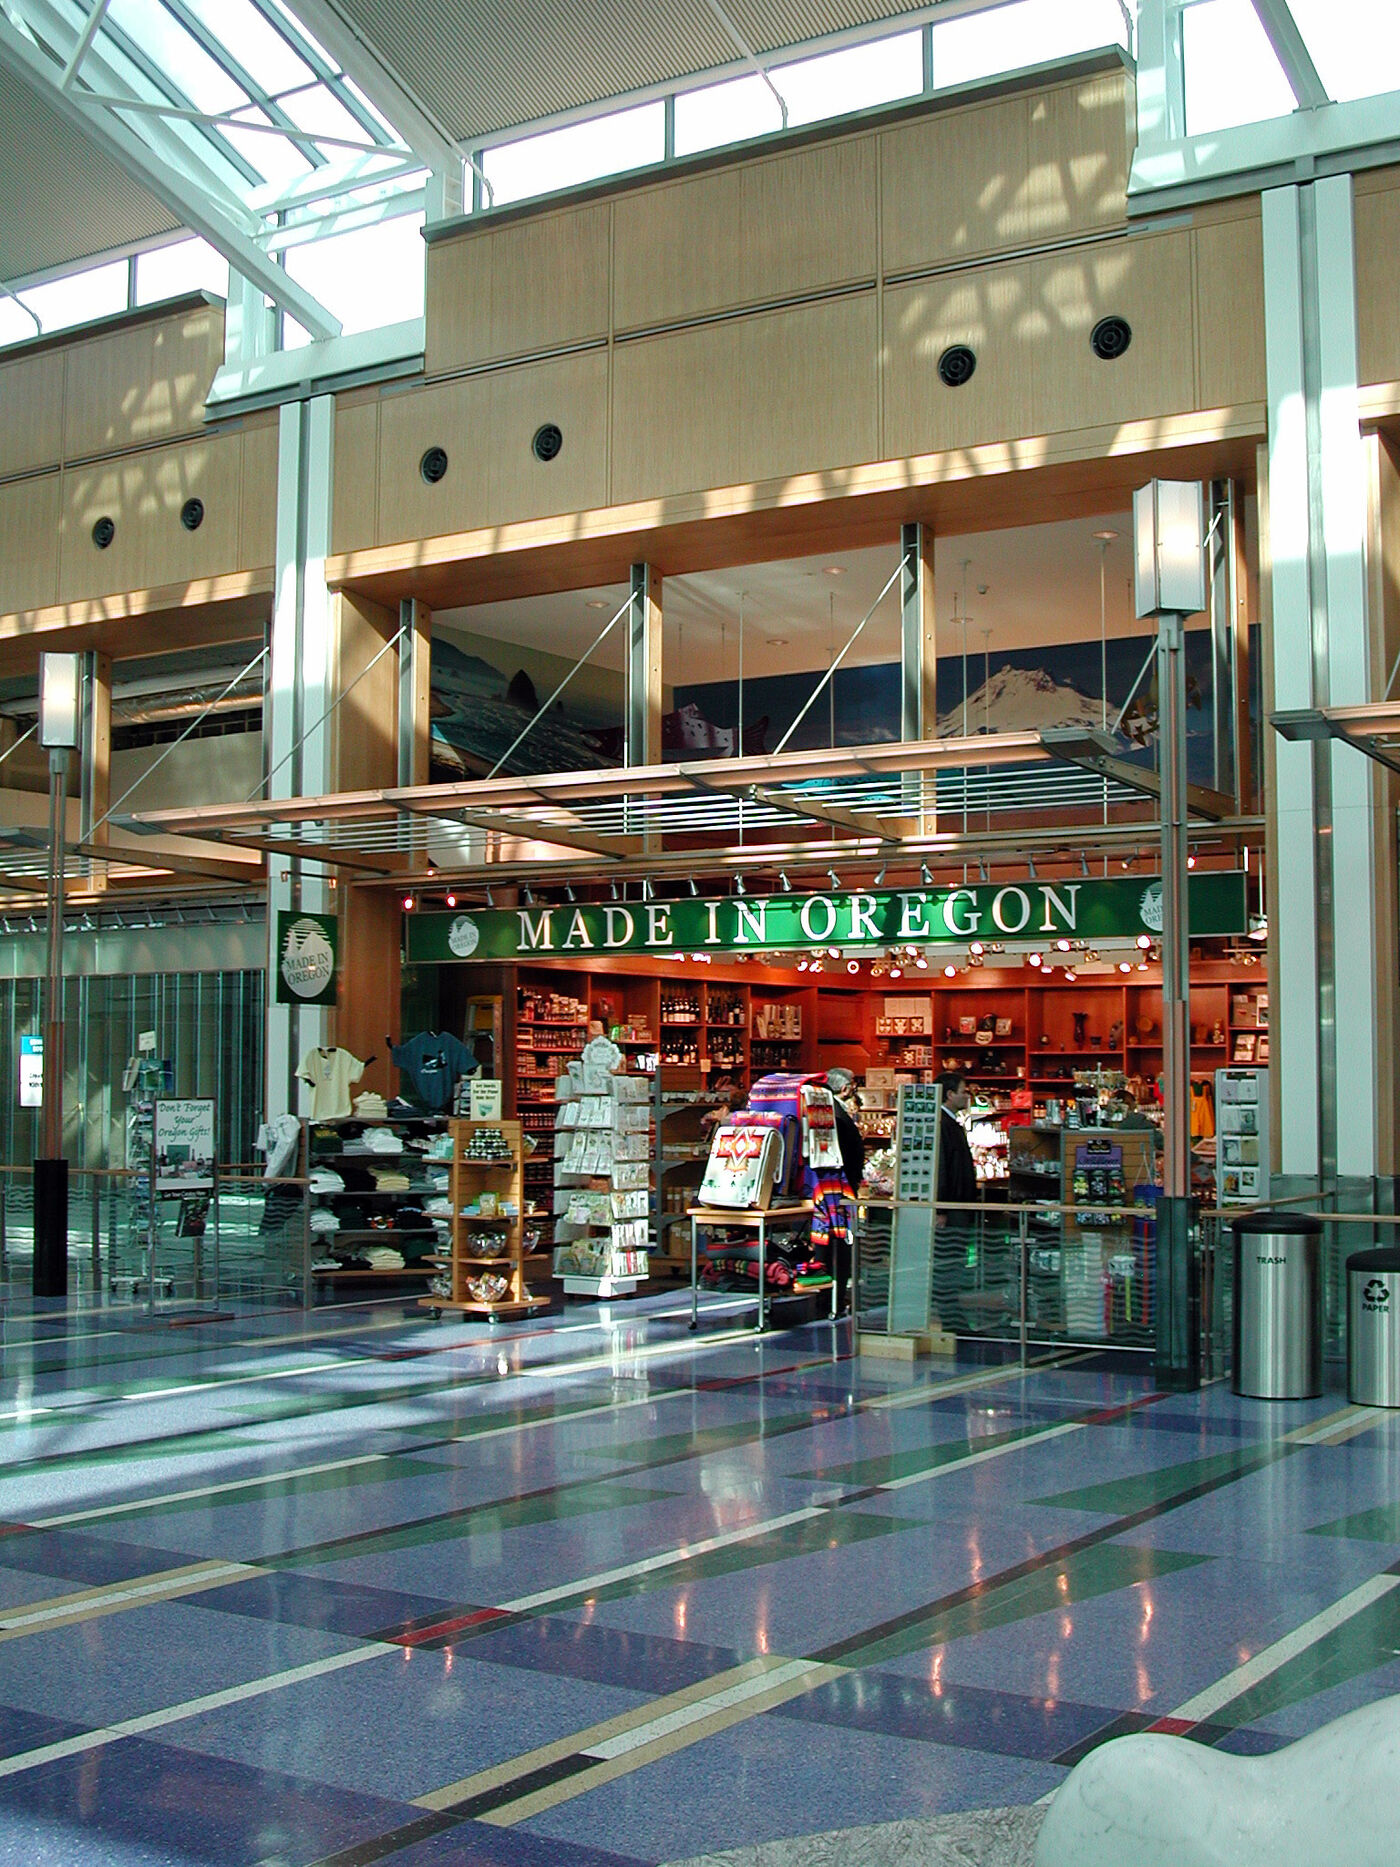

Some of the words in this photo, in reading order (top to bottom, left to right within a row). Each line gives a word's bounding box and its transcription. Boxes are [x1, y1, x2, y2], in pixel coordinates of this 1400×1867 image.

[516, 904, 674, 950] MADE
[703, 899, 770, 945] IN
[800, 885, 1082, 941] OREGON
[287, 955, 315, 972] MADE
[317, 952, 329, 964] IN
[287, 965, 330, 985] OREGON
[159, 1103, 181, 1112] Don't
[183, 1103, 211, 1118] Forget
[173, 1116, 196, 1129] Your
[158, 1128, 187, 1143] Oregon
[187, 1126, 211, 1142] Gifts!
[1256, 1256, 1287, 1264] TRASH
[1362, 1303, 1390, 1312] PAPER
